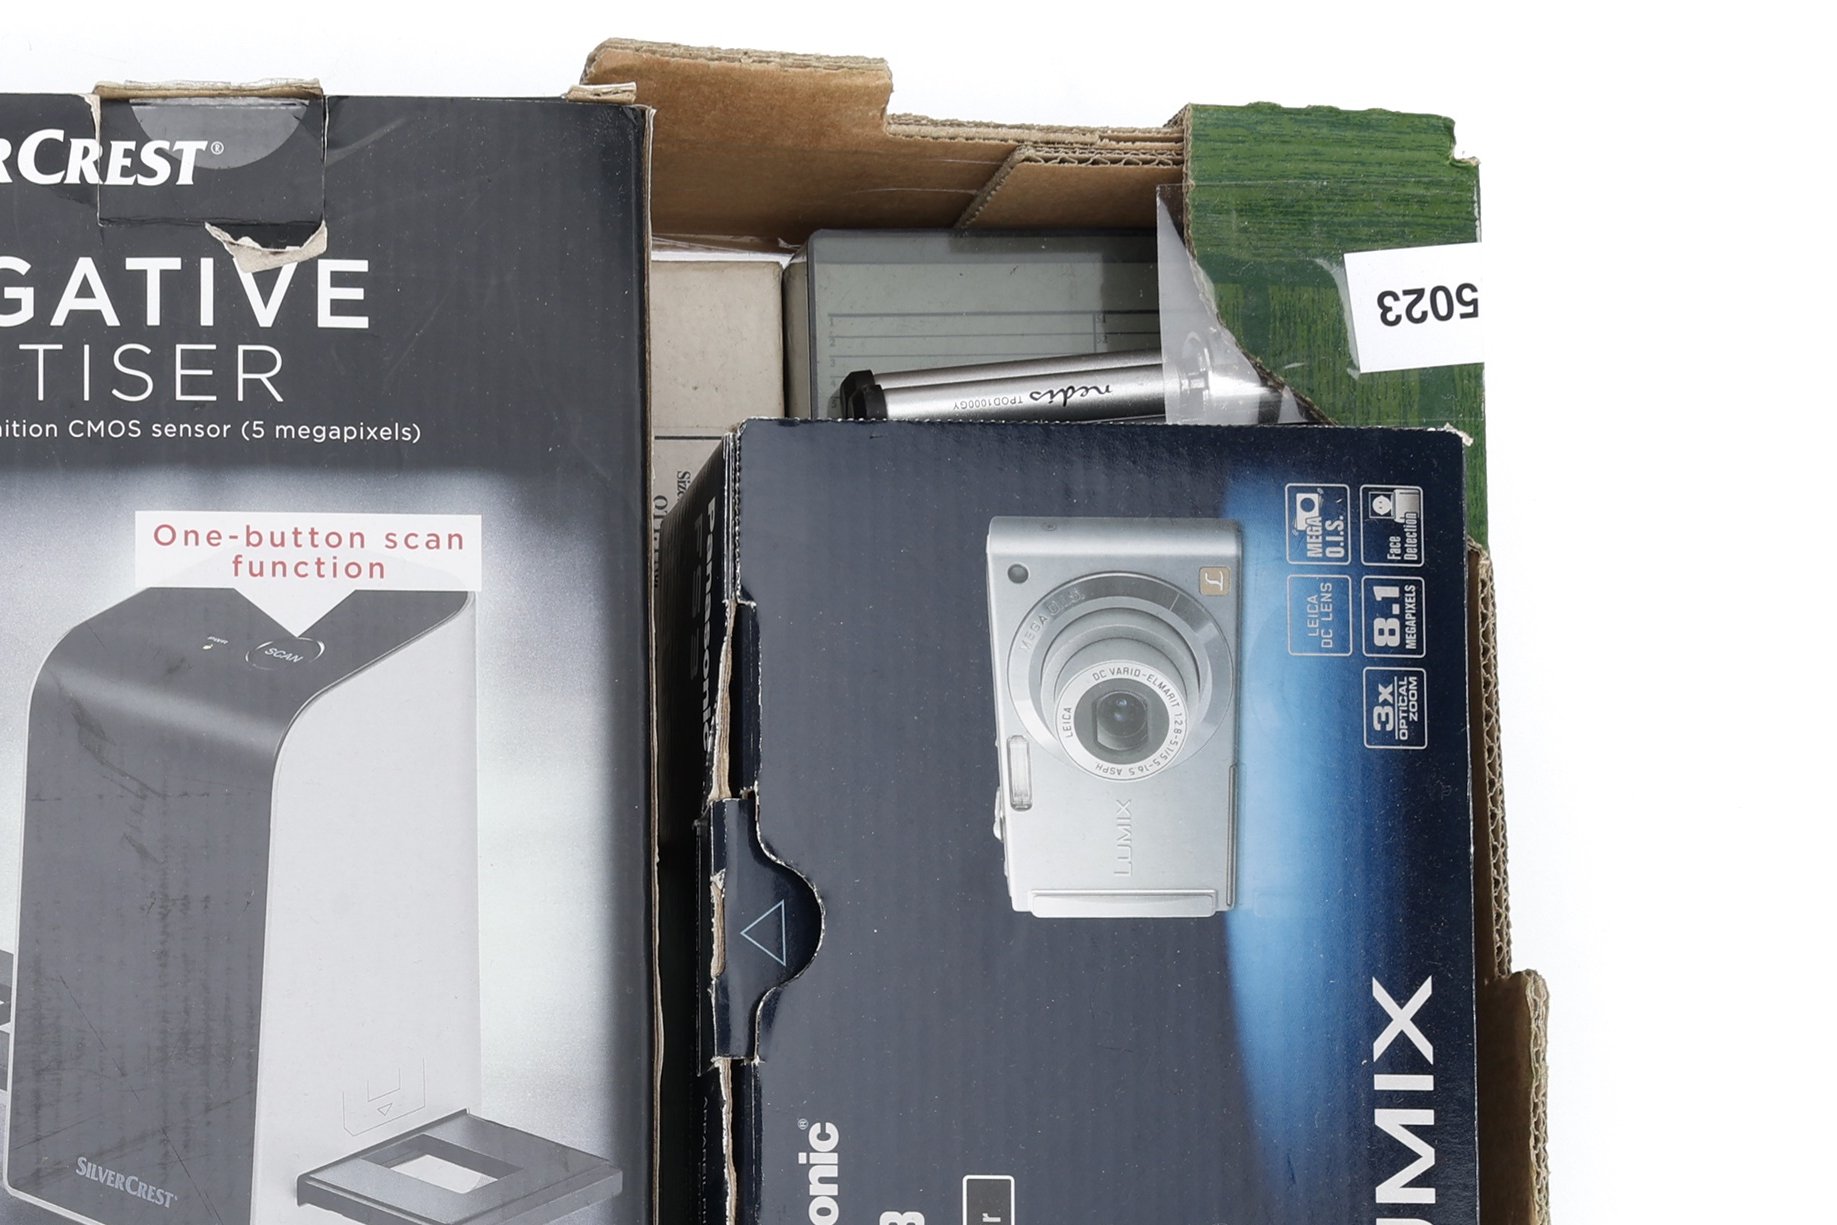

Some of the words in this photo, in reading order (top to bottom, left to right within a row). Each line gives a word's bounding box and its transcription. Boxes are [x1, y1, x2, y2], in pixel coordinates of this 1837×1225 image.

[1377, 282, 1479, 327] 5023
[953, 396, 1023, 411] TPOD1000GY
[1029, 385, 1112, 407] nedis
[68, 419, 142, 439] CMOS
[151, 423, 231, 439] sensor
[241, 418, 266, 442] (5
[274, 420, 421, 446] megapixels)
[153, 523, 365, 550] One-button
[384, 531, 465, 551] scan
[1307, 515, 1323, 558] MEGA
[1325, 515, 1345, 558] O.I.S.
[1388, 535, 1401, 561] Face
[1404, 511, 1418, 561] Detection
[232, 555, 386, 580] function
[1307, 594, 1320, 637] LEICA
[1322, 582, 1334, 622] LENS
[1373, 585, 1401, 648] 8.1
[1405, 584, 1417, 649] MEGAPIXELS
[264, 646, 303, 664] SCAN
[1322, 628, 1334, 649] DC
[1062, 706, 1073, 738] LEICA
[1092, 669, 1107, 682] DC
[1110, 666, 1180, 708] VARIO-ELMARIT
[1373, 683, 1395, 732] 3x
[1398, 676, 1409, 740] OPTICAL
[1409, 676, 1419, 723] ZOOM
[1114, 799, 1132, 877] LUMIX
